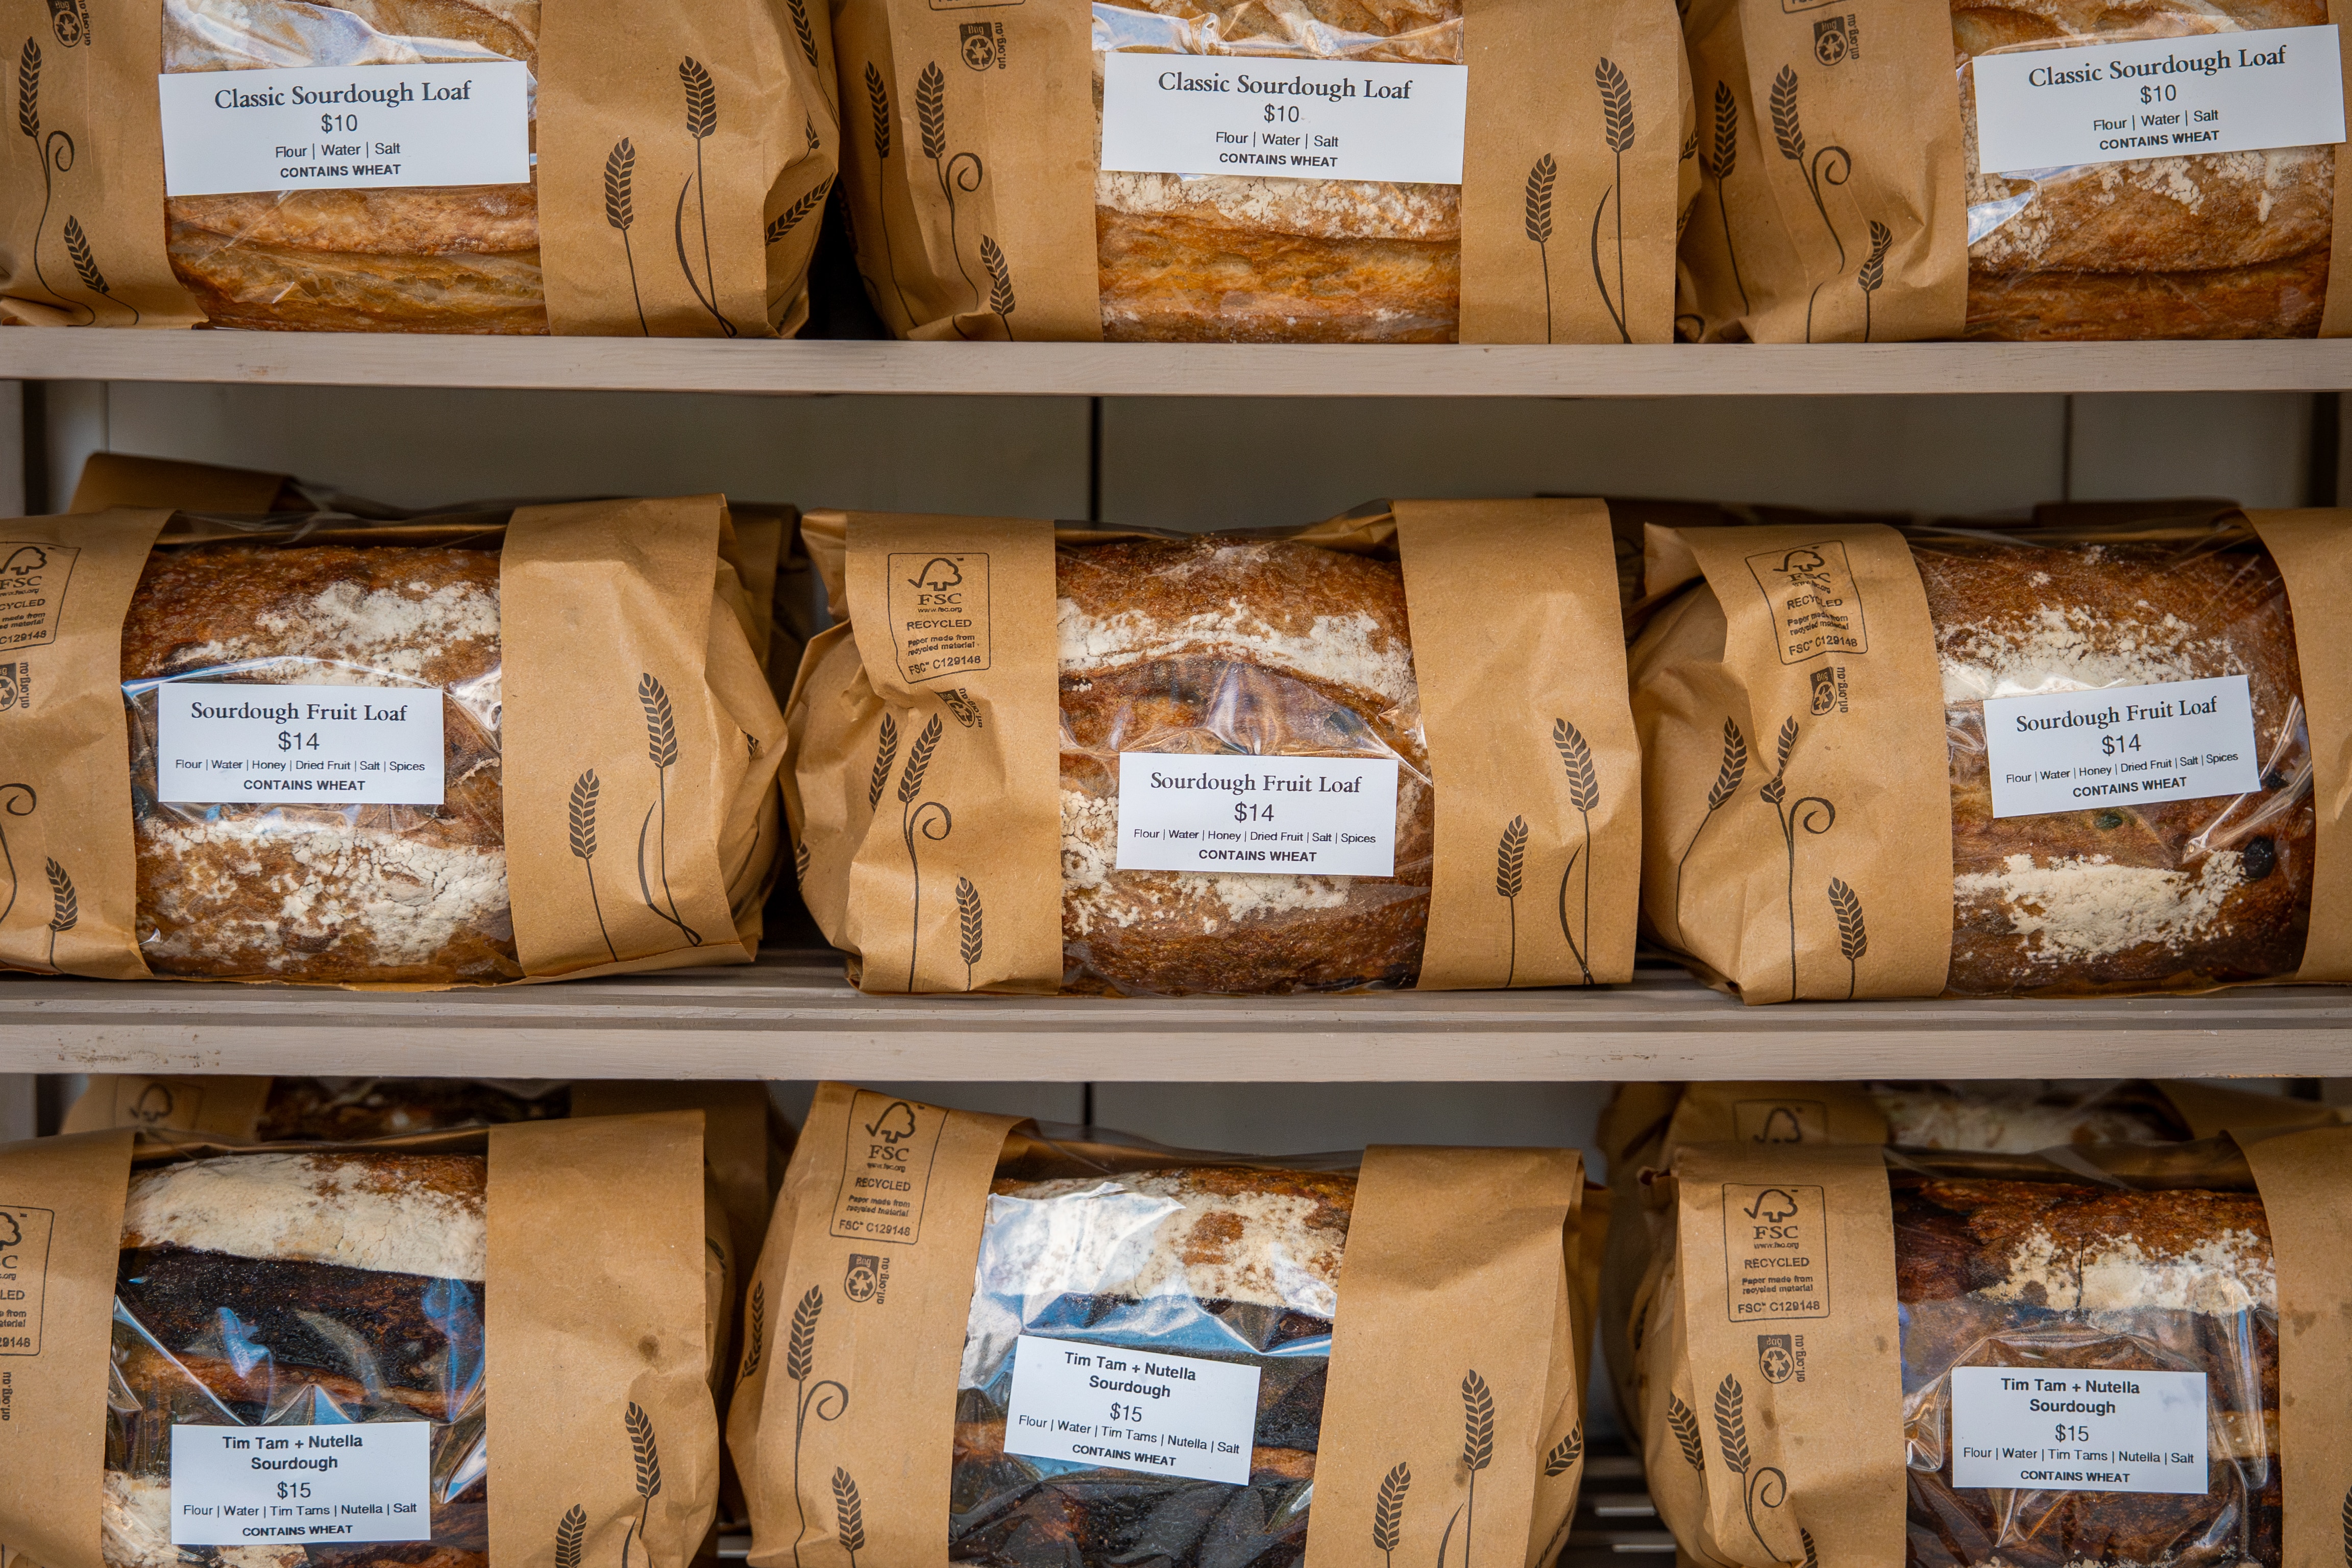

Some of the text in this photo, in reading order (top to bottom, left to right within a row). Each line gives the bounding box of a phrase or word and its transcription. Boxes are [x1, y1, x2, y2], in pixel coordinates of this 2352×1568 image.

[2028, 44, 2287, 87] Classic Sourdough Loaf
[215, 80, 472, 109] Classic Sourdough Loaf
[1158, 71, 1413, 103] Classic Sourdough Loaf
[2140, 84, 2176, 105] $10
[1264, 103, 1300, 124] $10
[2093, 109, 2219, 131] Flour Water Salt
[321, 113, 358, 134] $10
[1216, 131, 1339, 148] Flour Water Salt
[2099, 130, 2220, 150] CONTAINS WHEAT
[276, 142, 401, 158] Flour Water Salt
[1219, 153, 1338, 167] CONTAINS WHEAT
[280, 164, 402, 178] CONTAINS WHEAT
[0, 576, 43, 590] FSC
[1786, 572, 1831, 583] FSC
[0, 599, 46, 611] CYCLED
[917, 593, 962, 605] FSC
[1786, 594, 1843, 610] RECYCLED
[906, 619, 972, 631] RECYCLED
[0, 630, 47, 645] C129148
[1815, 634, 1858, 647] C129148
[933, 655, 981, 670] C129148
[191, 701, 408, 724] Sourdough Fruit Loaf
[2016, 695, 2217, 732] Sourdough Fruit Loaf
[278, 730, 320, 752] $14
[2101, 733, 2142, 757] $14
[176, 759, 425, 773] Flour Water Honey Dried Fruit Salt Spices
[2006, 753, 2239, 783] Flour Water Honey Dried Fruit Salt Spices
[243, 779, 366, 791] CONTAINS WHEAT
[1150, 772, 1363, 796] Sourdough Fruit Loaf
[2073, 776, 2187, 797] CONTAINS WHEAT
[1234, 801, 1275, 823] $14
[1134, 828, 1376, 845] Flour Water Honey Dried Fruit Salt Spices
[1198, 849, 1317, 862] CONTAINS WHEAT
[868, 1144, 910, 1162] FSC
[854, 1177, 911, 1192] RECYCLED
[866, 1222, 911, 1236] C129148
[1753, 1225, 1799, 1240] FSC
[1744, 1257, 1810, 1269] RECYCLED
[1770, 1300, 1820, 1312] C129148
[1065, 1351, 1196, 1381] Tim Tam + Nutella
[1089, 1375, 1170, 1400] Sourdough
[2000, 1378, 2140, 1394] Tim Tam + Nutella
[1110, 1402, 1142, 1422] $15
[2029, 1399, 2116, 1416] Sourdough
[1019, 1414, 1240, 1454] Flour Water Tim Tams Nutella Salt
[2055, 1423, 2089, 1443] $15
[222, 1434, 363, 1450] Tim Tam + Nutella
[1072, 1444, 1177, 1466] CONTAINS WHEAT
[1964, 1447, 2194, 1464] Flour Water Tim Tams Nutella Salt
[251, 1456, 338, 1472] Sourdough
[2020, 1470, 2130, 1483] CONTAINS WHEAT
[277, 1481, 311, 1500] $15
[184, 1503, 417, 1516] Flour Water Tim Tams Nutella Salt
[242, 1525, 353, 1536] CONTAINS WHEAT
